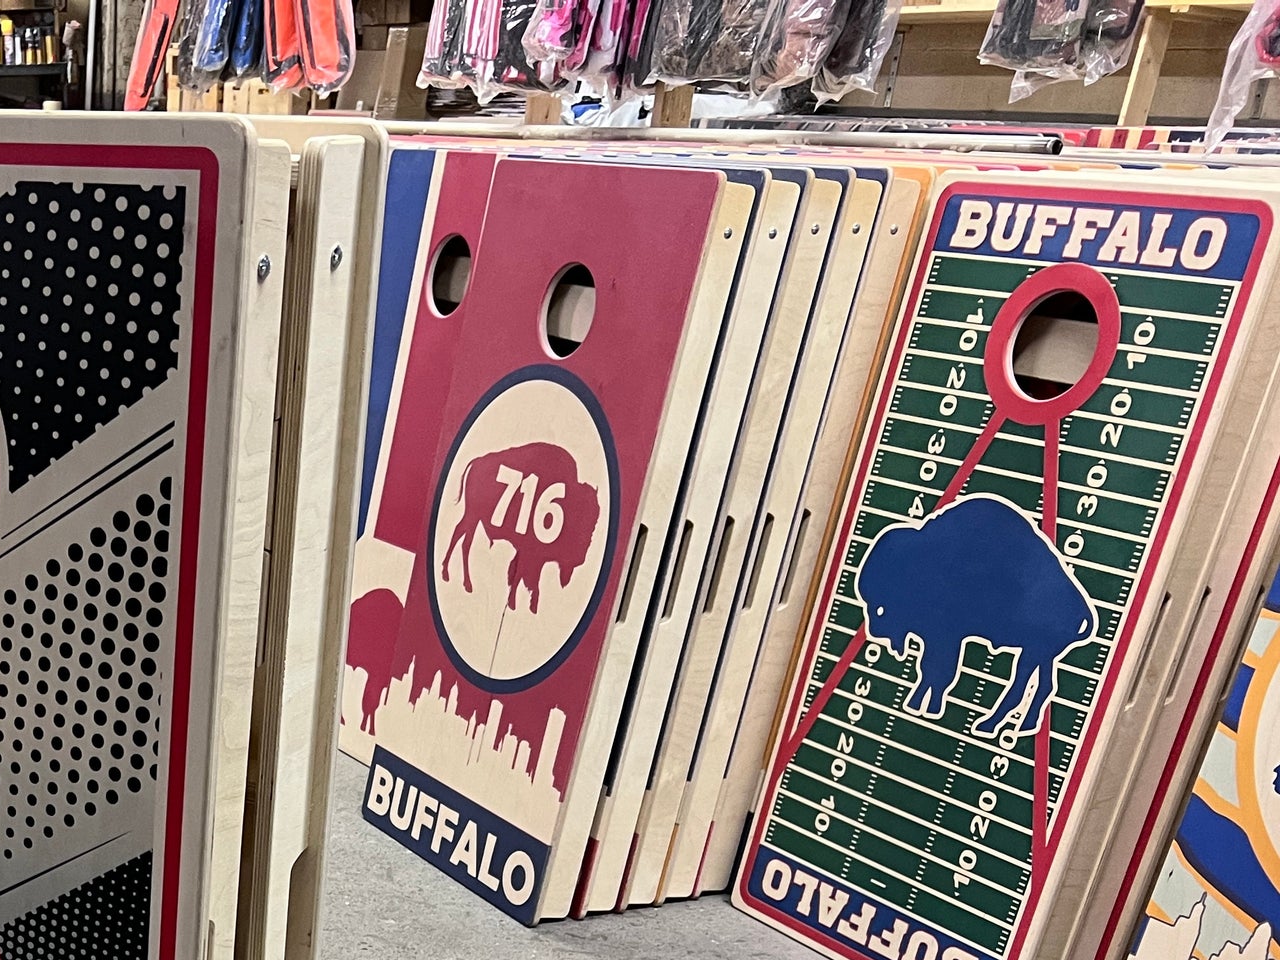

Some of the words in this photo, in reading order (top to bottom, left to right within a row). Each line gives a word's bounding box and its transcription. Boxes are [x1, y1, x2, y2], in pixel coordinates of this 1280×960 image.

[949, 199, 1227, 271] BUFFALO
[490, 464, 567, 544] 716
[366, 764, 536, 906] BUFFALO
